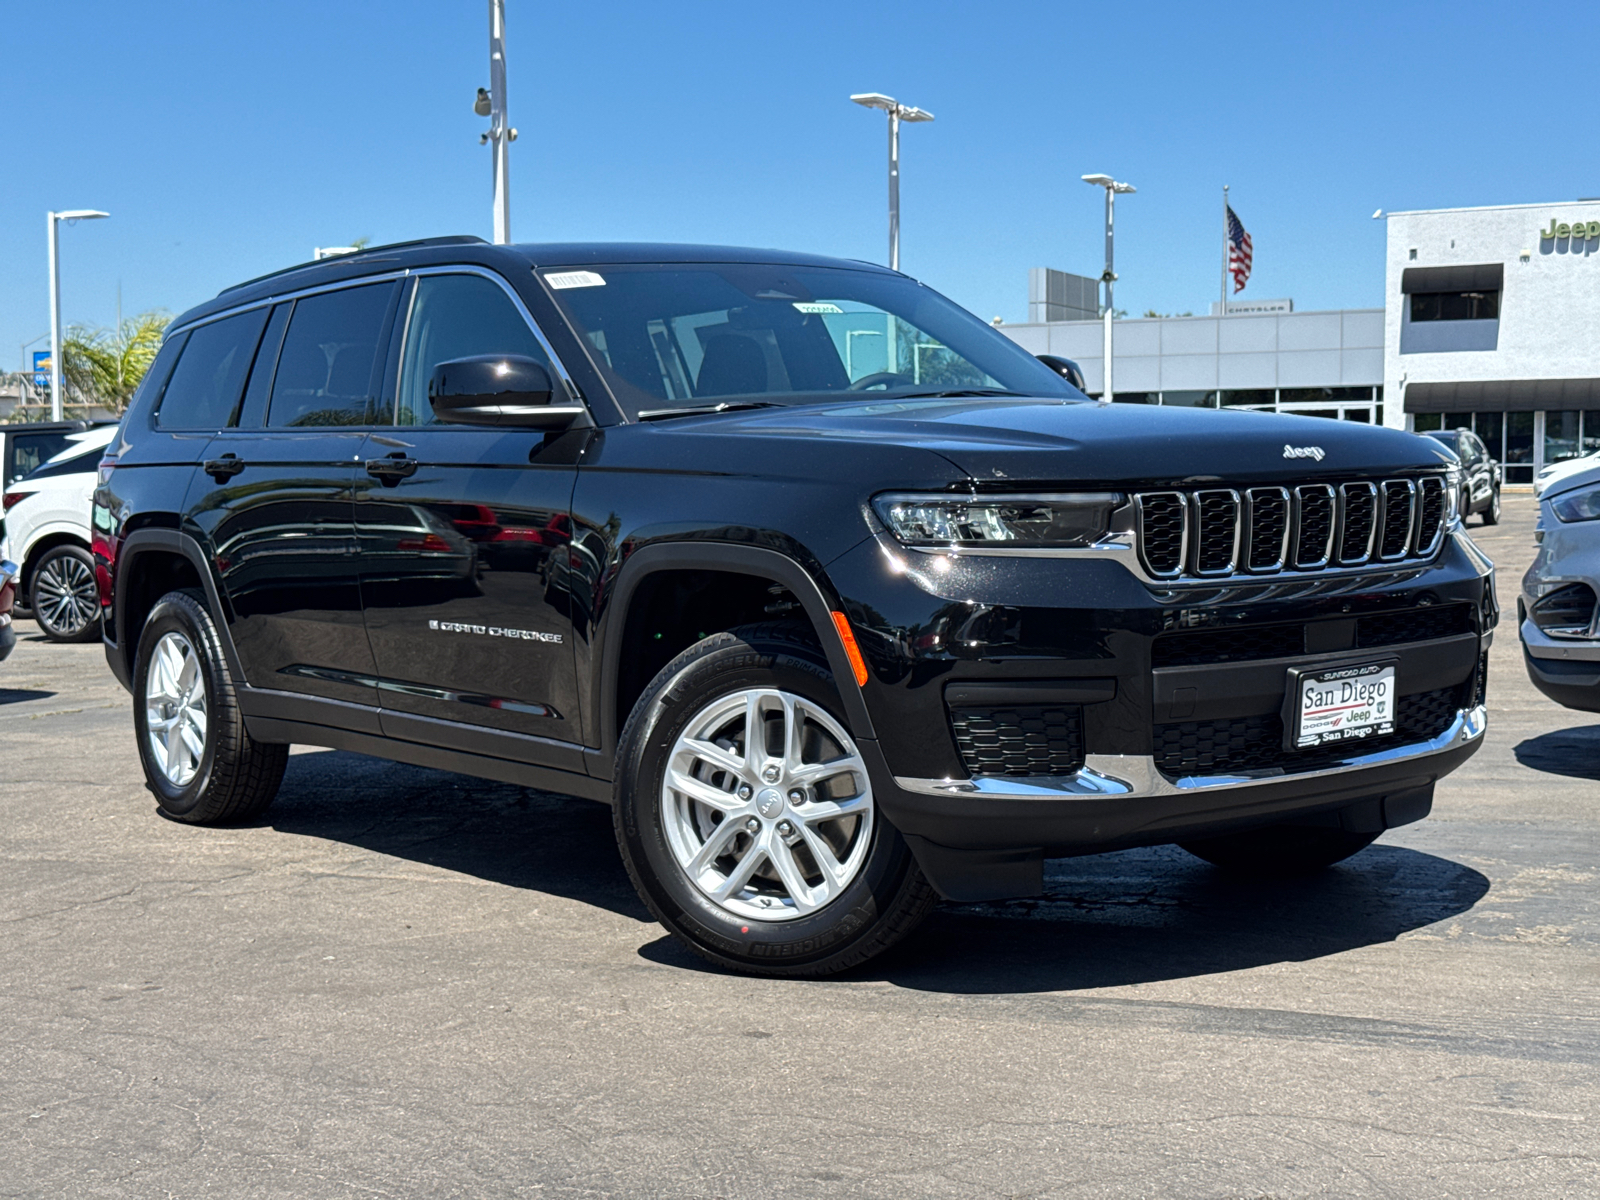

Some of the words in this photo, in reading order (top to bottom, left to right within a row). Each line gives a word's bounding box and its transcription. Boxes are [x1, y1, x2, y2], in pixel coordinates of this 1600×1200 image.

[1540, 218, 1600, 240] Jeep
[1283, 444, 1326, 462] Jeep
[440, 621, 486, 635] GRAND
[488, 627, 563, 644] CHEROKEE
[786, 658, 834, 681] PRIMACY
[1304, 687, 1334, 709] San
[1341, 679, 1386, 706] Diego
[1346, 710, 1371, 722] Jeep
[1322, 732, 1342, 742] San
[1344, 727, 1372, 738] Diego
